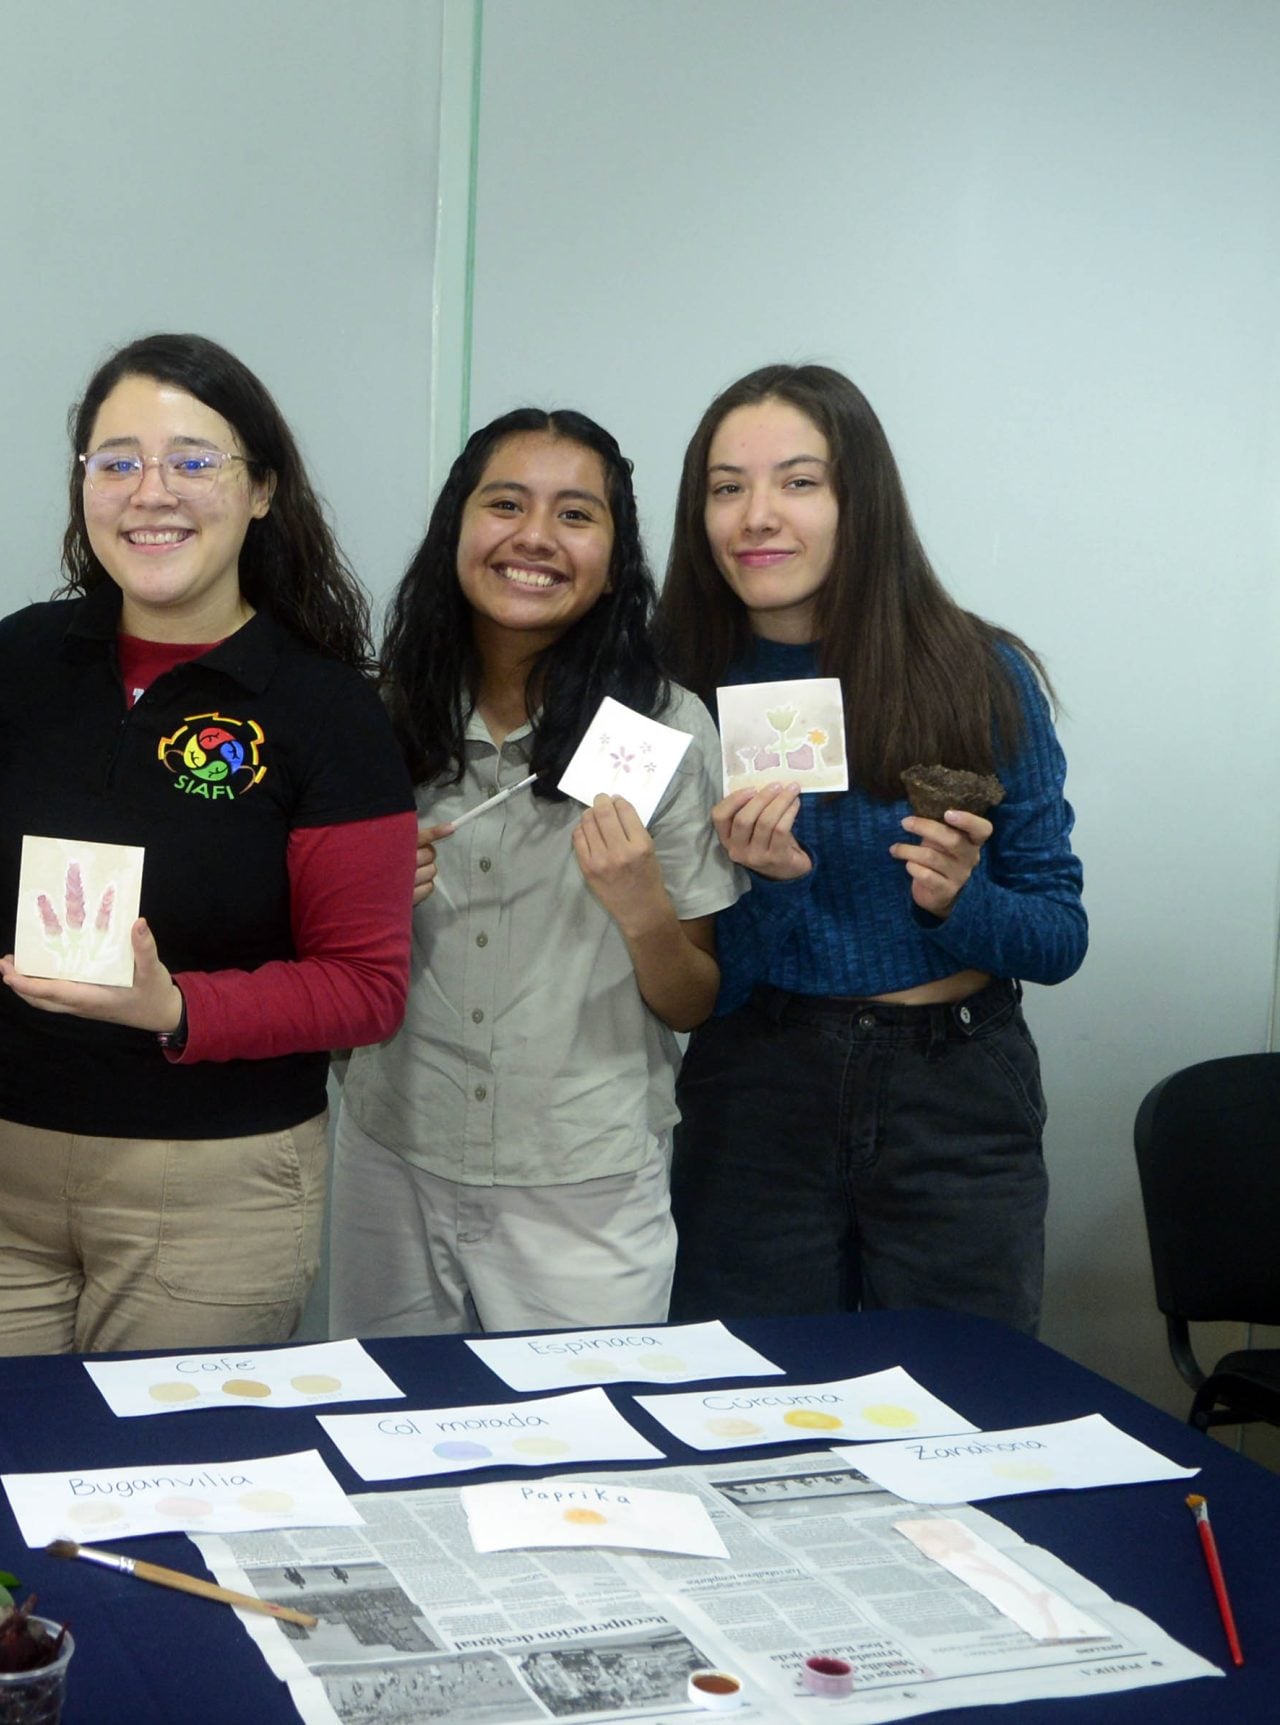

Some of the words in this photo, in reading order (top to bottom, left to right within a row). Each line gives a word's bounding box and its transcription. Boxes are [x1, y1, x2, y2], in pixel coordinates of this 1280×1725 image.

[174, 774, 235, 800] SIAFI
[527, 1333, 662, 1358] Espinaca
[377, 1418, 421, 1436] Col
[436, 1412, 550, 1433] morada
[69, 1472, 254, 1498] Buganvilia
[521, 1487, 631, 1505] Paprika
[537, 1615, 670, 1642] Recuperación
[452, 1633, 535, 1651] desigual
